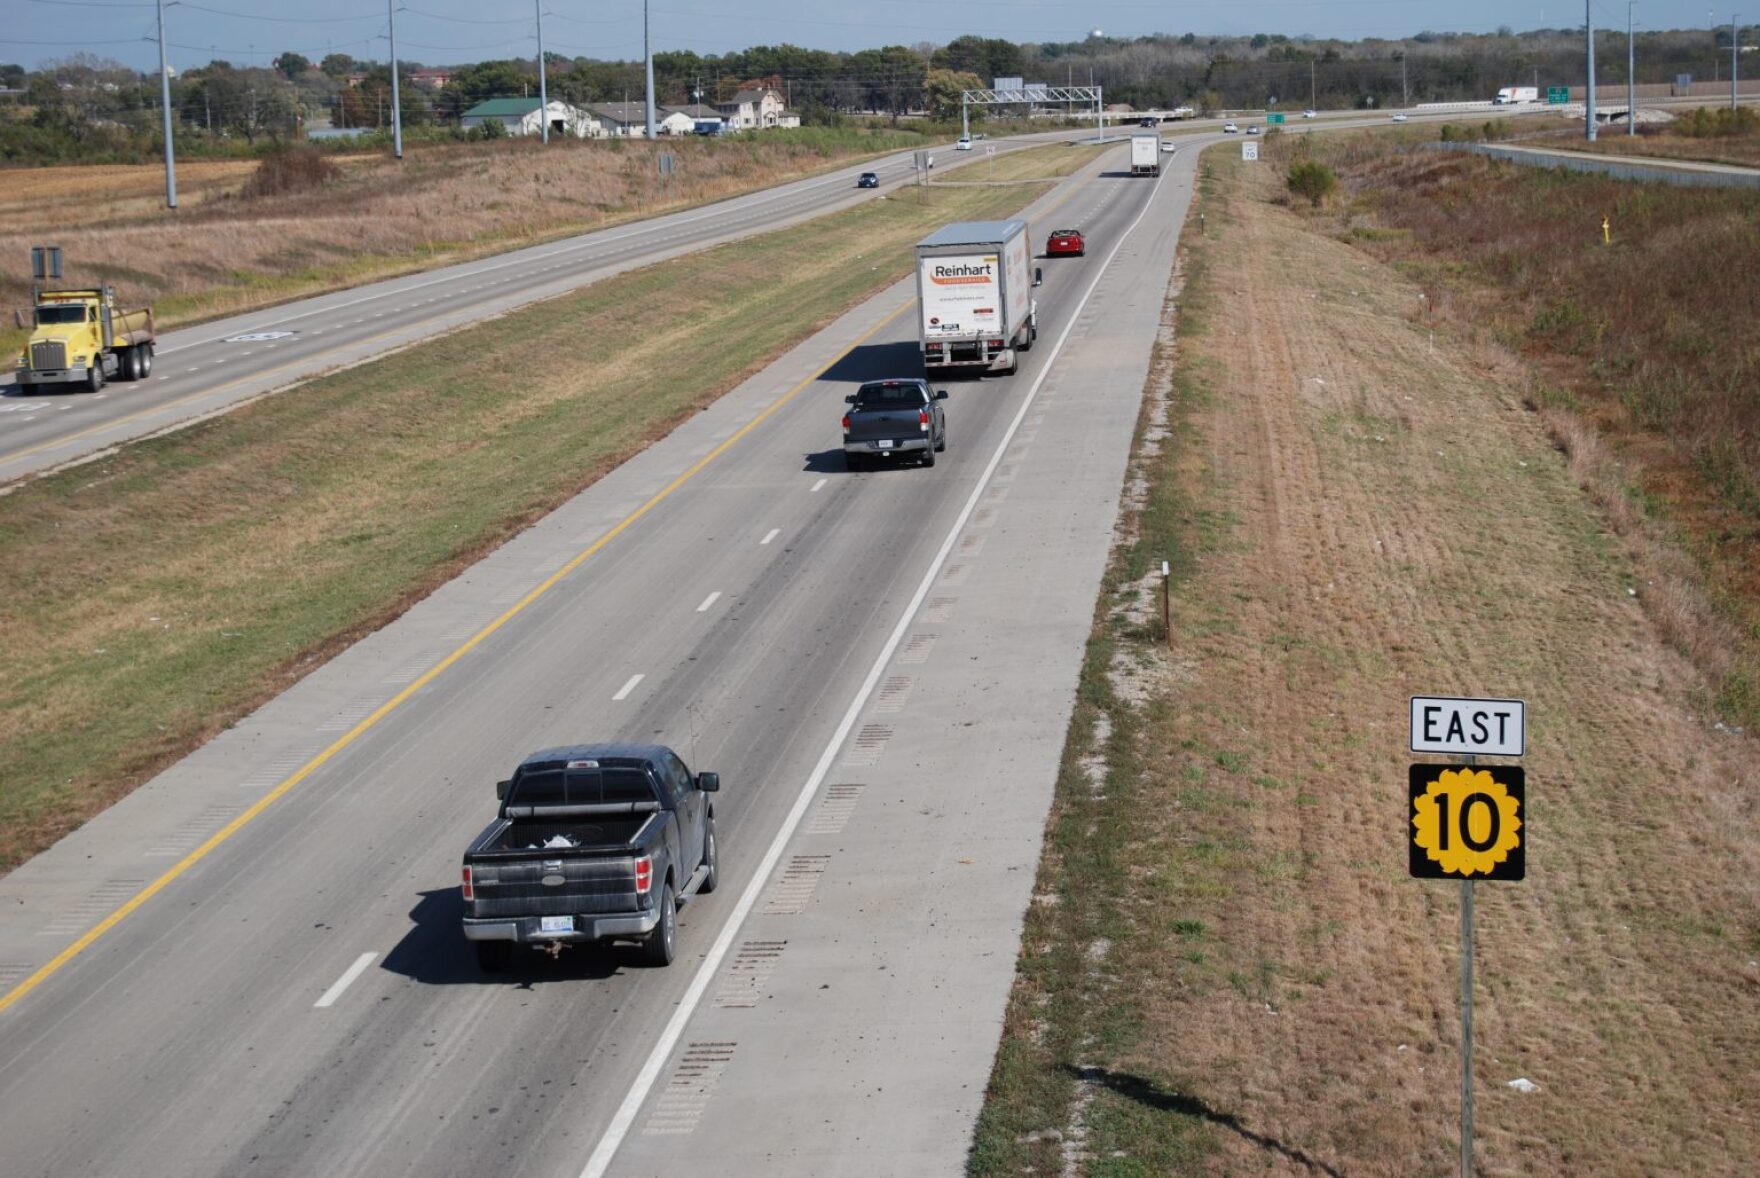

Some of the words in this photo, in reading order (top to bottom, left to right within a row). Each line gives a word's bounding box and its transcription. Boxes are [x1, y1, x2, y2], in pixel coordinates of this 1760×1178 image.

[1245, 151, 1256, 159] 70
[935, 264, 992, 277] Reinhart
[1423, 706, 1511, 745] EAST
[1434, 792, 1500, 852] 10
